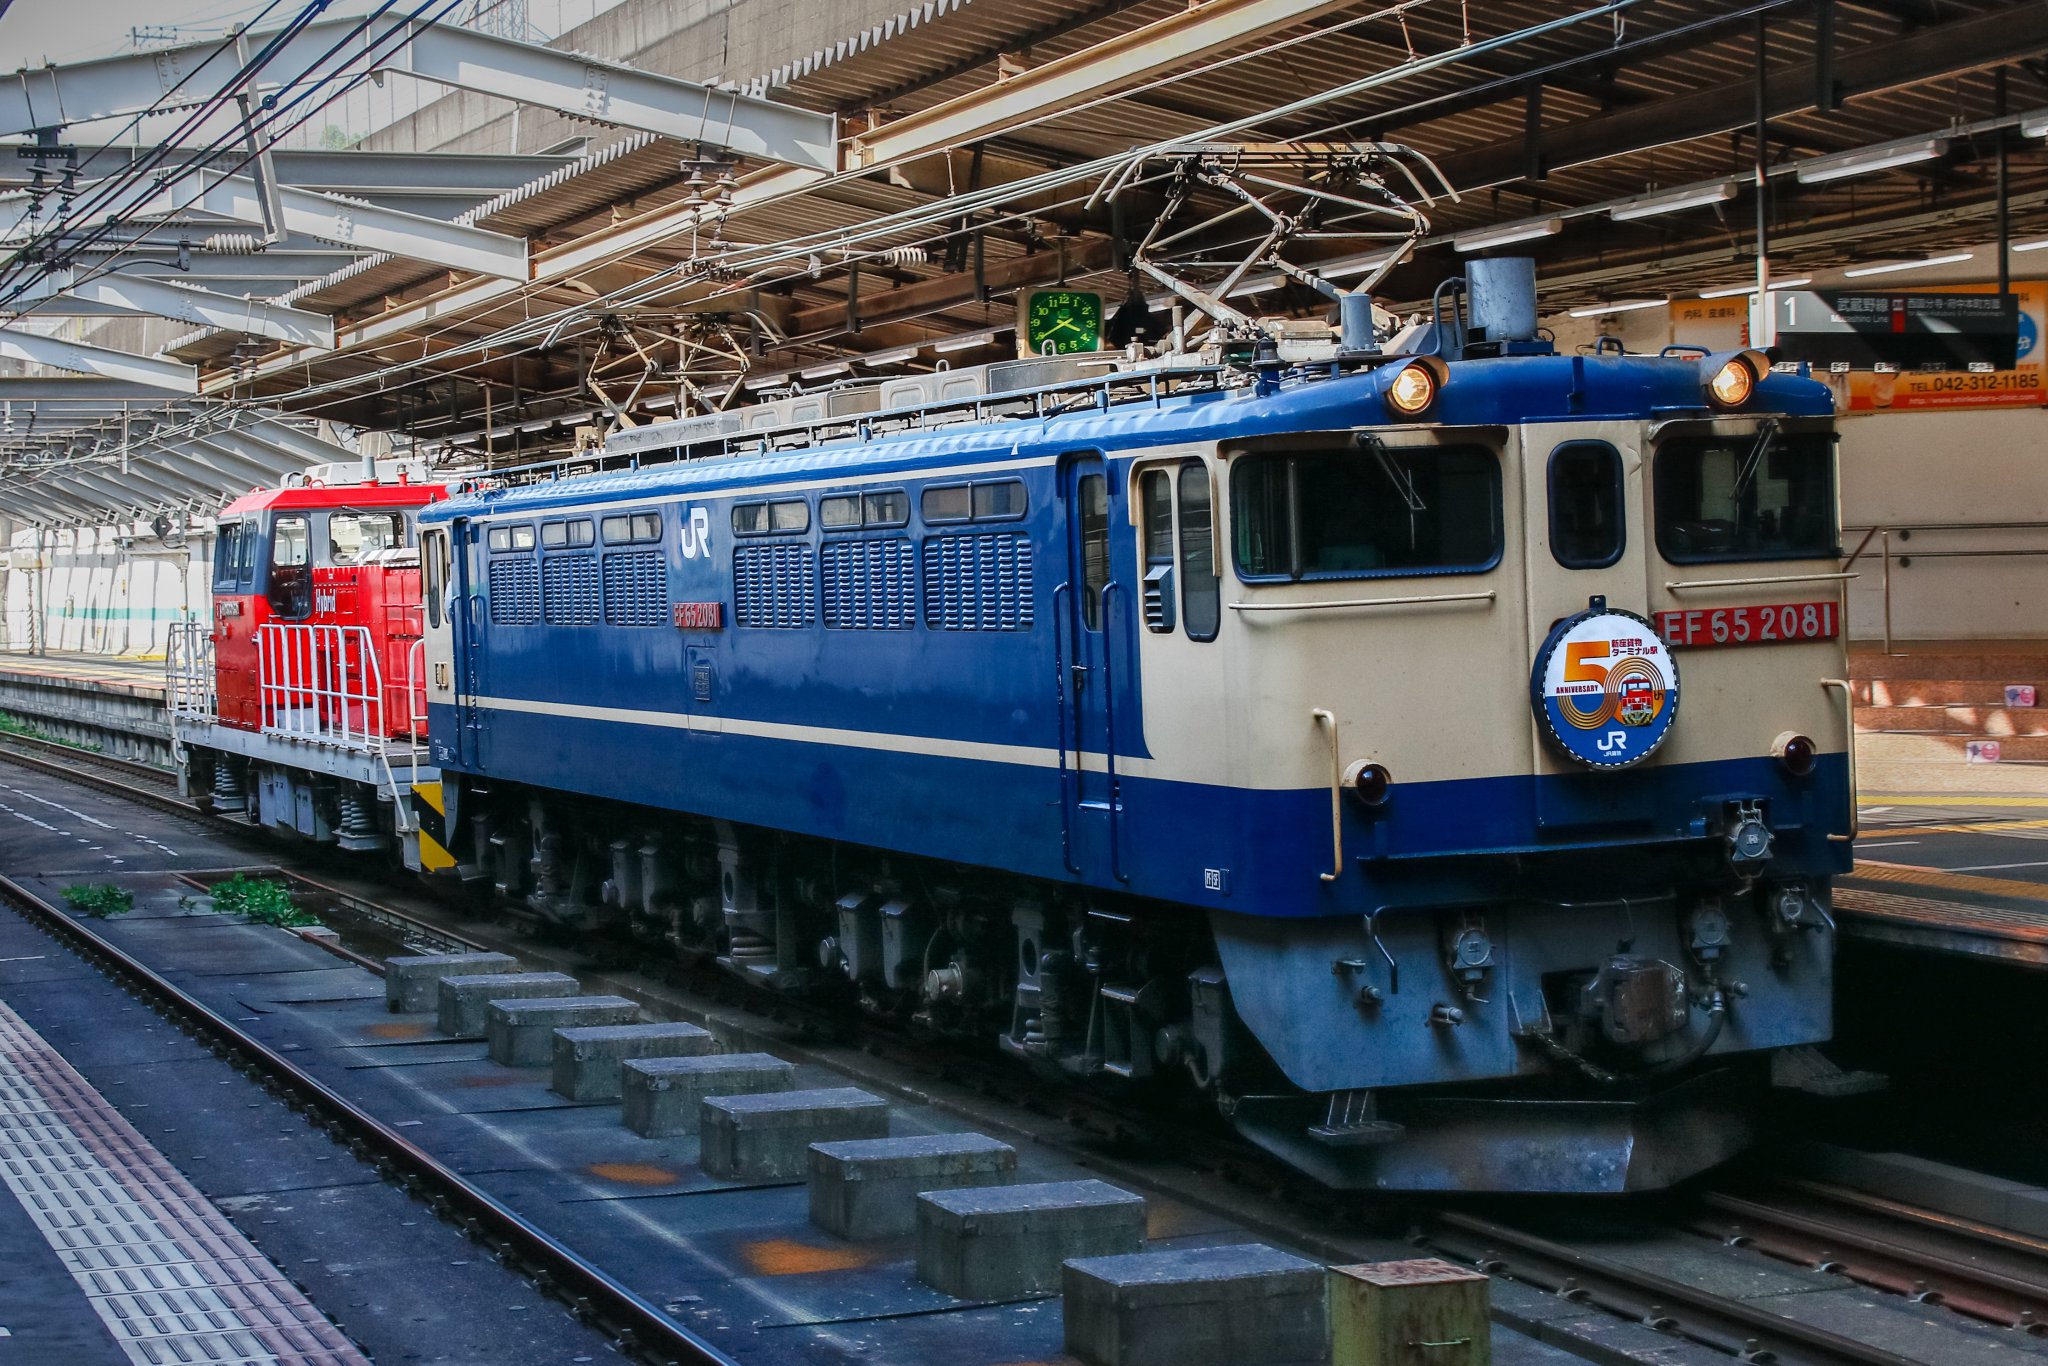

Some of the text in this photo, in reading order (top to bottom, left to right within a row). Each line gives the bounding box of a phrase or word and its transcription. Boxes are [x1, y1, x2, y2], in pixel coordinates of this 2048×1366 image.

[1048, 299, 1058, 308] 11
[1058, 296, 1070, 304] 12
[1073, 299, 1078, 307] 1
[1038, 307, 1049, 316] 10
[1081, 306, 1089, 315] 2
[1784, 296, 1796, 326] 1
[1033, 318, 1041, 327] 9
[1086, 320, 1093, 328] 3
[1080, 332, 1088, 341] 4
[1058, 342, 1066, 351] 6
[1069, 340, 1077, 349] 5
[680, 506, 711, 559] JR
[315, 588, 337, 618] Hybrid
[673, 604, 684, 627] EF
[685, 604, 697, 627] 65
[1663, 603, 1831, 646] EF 65 2081
[1611, 638, 1643, 648] 新座貨物
[1611, 645, 1658, 657] ターミナル駅
[1555, 685, 1599, 695] ANNIVERSARY
[1596, 730, 1627, 751] JR
